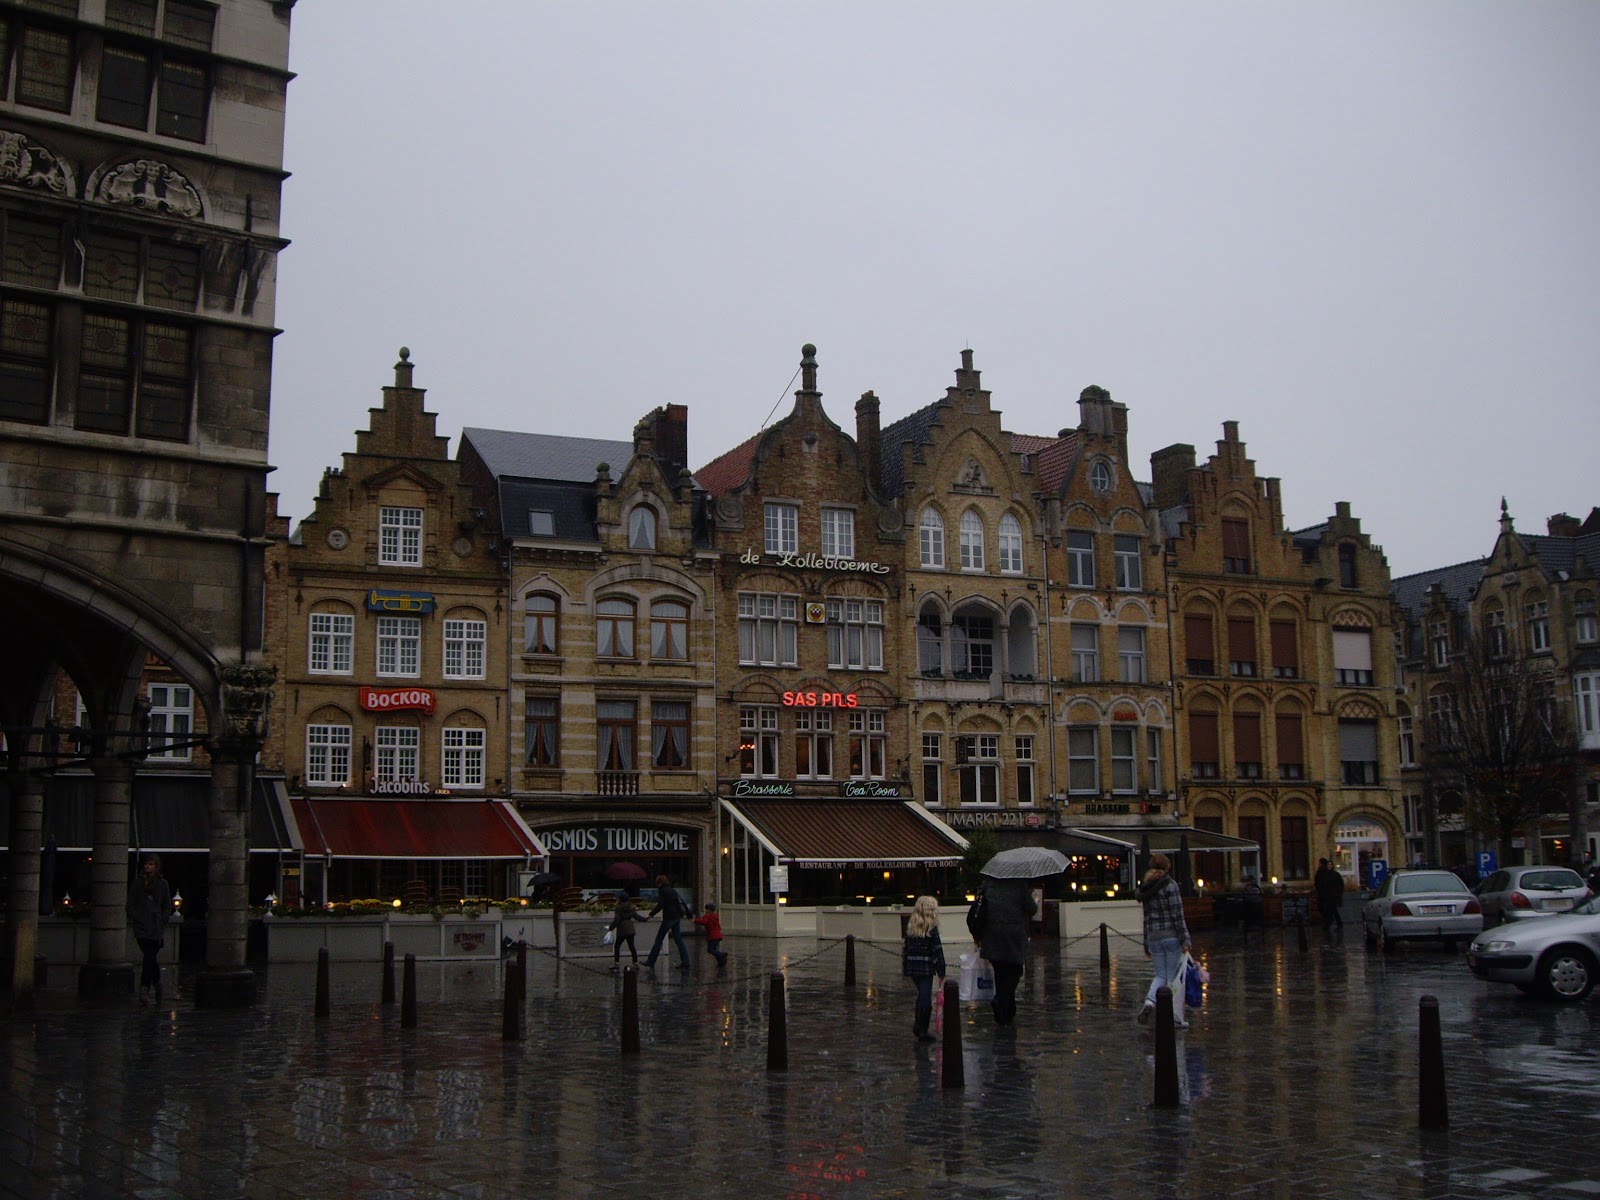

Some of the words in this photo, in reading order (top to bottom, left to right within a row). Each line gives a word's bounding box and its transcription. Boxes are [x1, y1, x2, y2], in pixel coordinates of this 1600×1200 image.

[739, 548, 760, 565] de
[776, 552, 890, 574] Kollebloeme
[367, 691, 431, 708] BOCKOR
[782, 691, 817, 707] SAS
[821, 692, 858, 708] PILS
[369, 776, 430, 795] Jacobins
[732, 779, 794, 796] Brasserie
[864, 781, 899, 797] Room
[1085, 804, 1130, 814] BRASSERIE
[603, 827, 690, 851] TOURISME
[800, 862, 847, 870] RESTAURANT
[854, 862, 864, 870] DE
[1480, 853, 1490, 868] P
[1372, 862, 1383, 877] P
